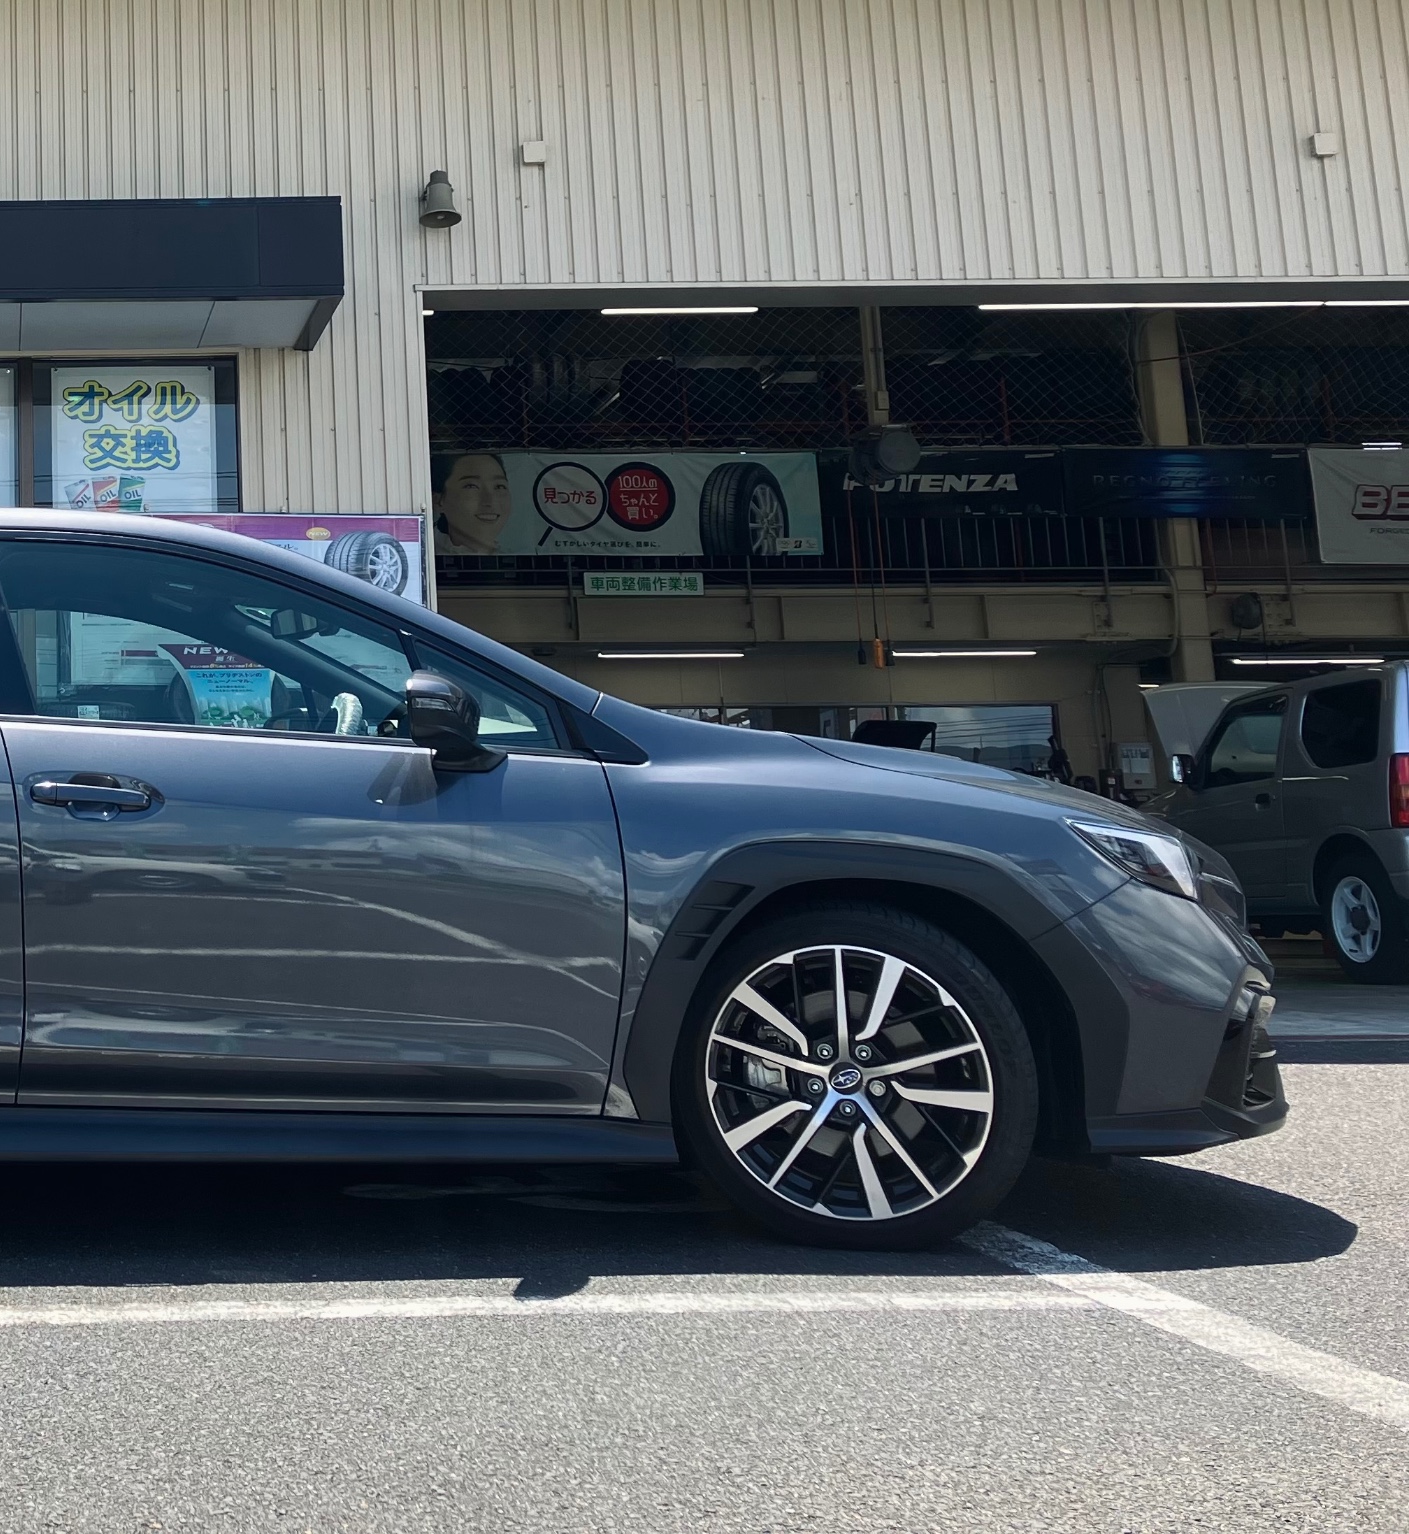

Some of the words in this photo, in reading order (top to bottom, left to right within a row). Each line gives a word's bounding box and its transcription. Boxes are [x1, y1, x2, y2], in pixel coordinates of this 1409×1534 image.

[62, 380, 200, 422] オイル
[83, 425, 180, 470] 交換
[618, 475, 658, 489] 100人の
[76, 493, 92, 509] OIL
[100, 489, 117, 503] OIL
[124, 489, 142, 500] OIL
[543, 487, 597, 505] 見つかる
[620, 493, 659, 506] ちゃんと
[590, 576, 699, 593] 車両整備作業場
